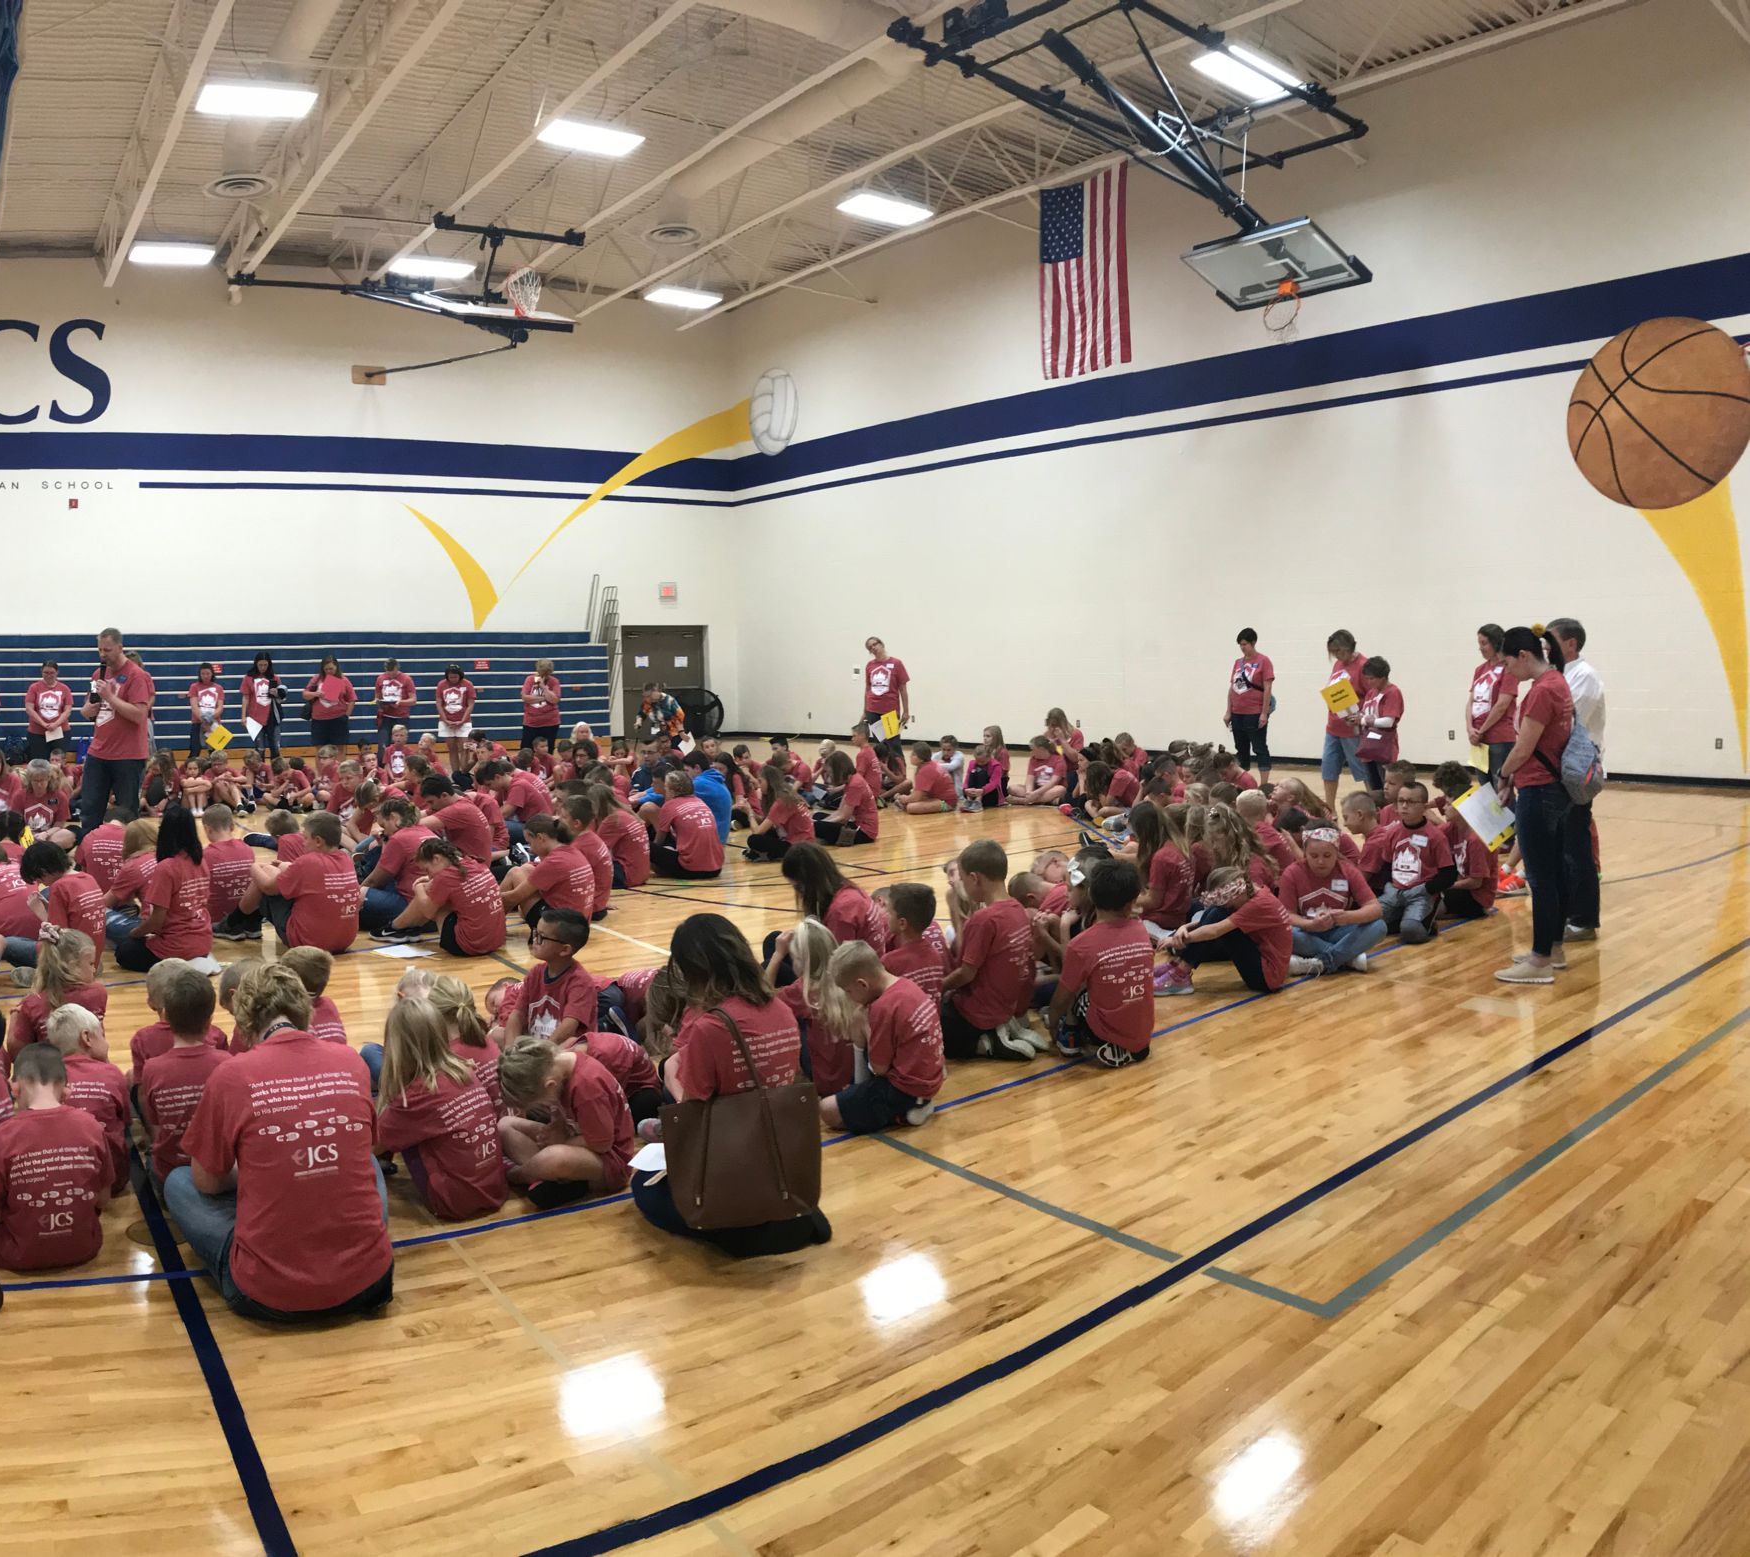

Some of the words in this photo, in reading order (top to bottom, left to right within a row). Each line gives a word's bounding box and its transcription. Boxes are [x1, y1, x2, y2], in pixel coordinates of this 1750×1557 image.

[41, 481, 113, 490] SCHOOL
[1130, 984, 1145, 998] JCS
[250, 1090, 269, 1098] works
[316, 1089, 335, 1097] called
[307, 1143, 339, 1168] JCS
[50, 1211, 74, 1231] JCS
